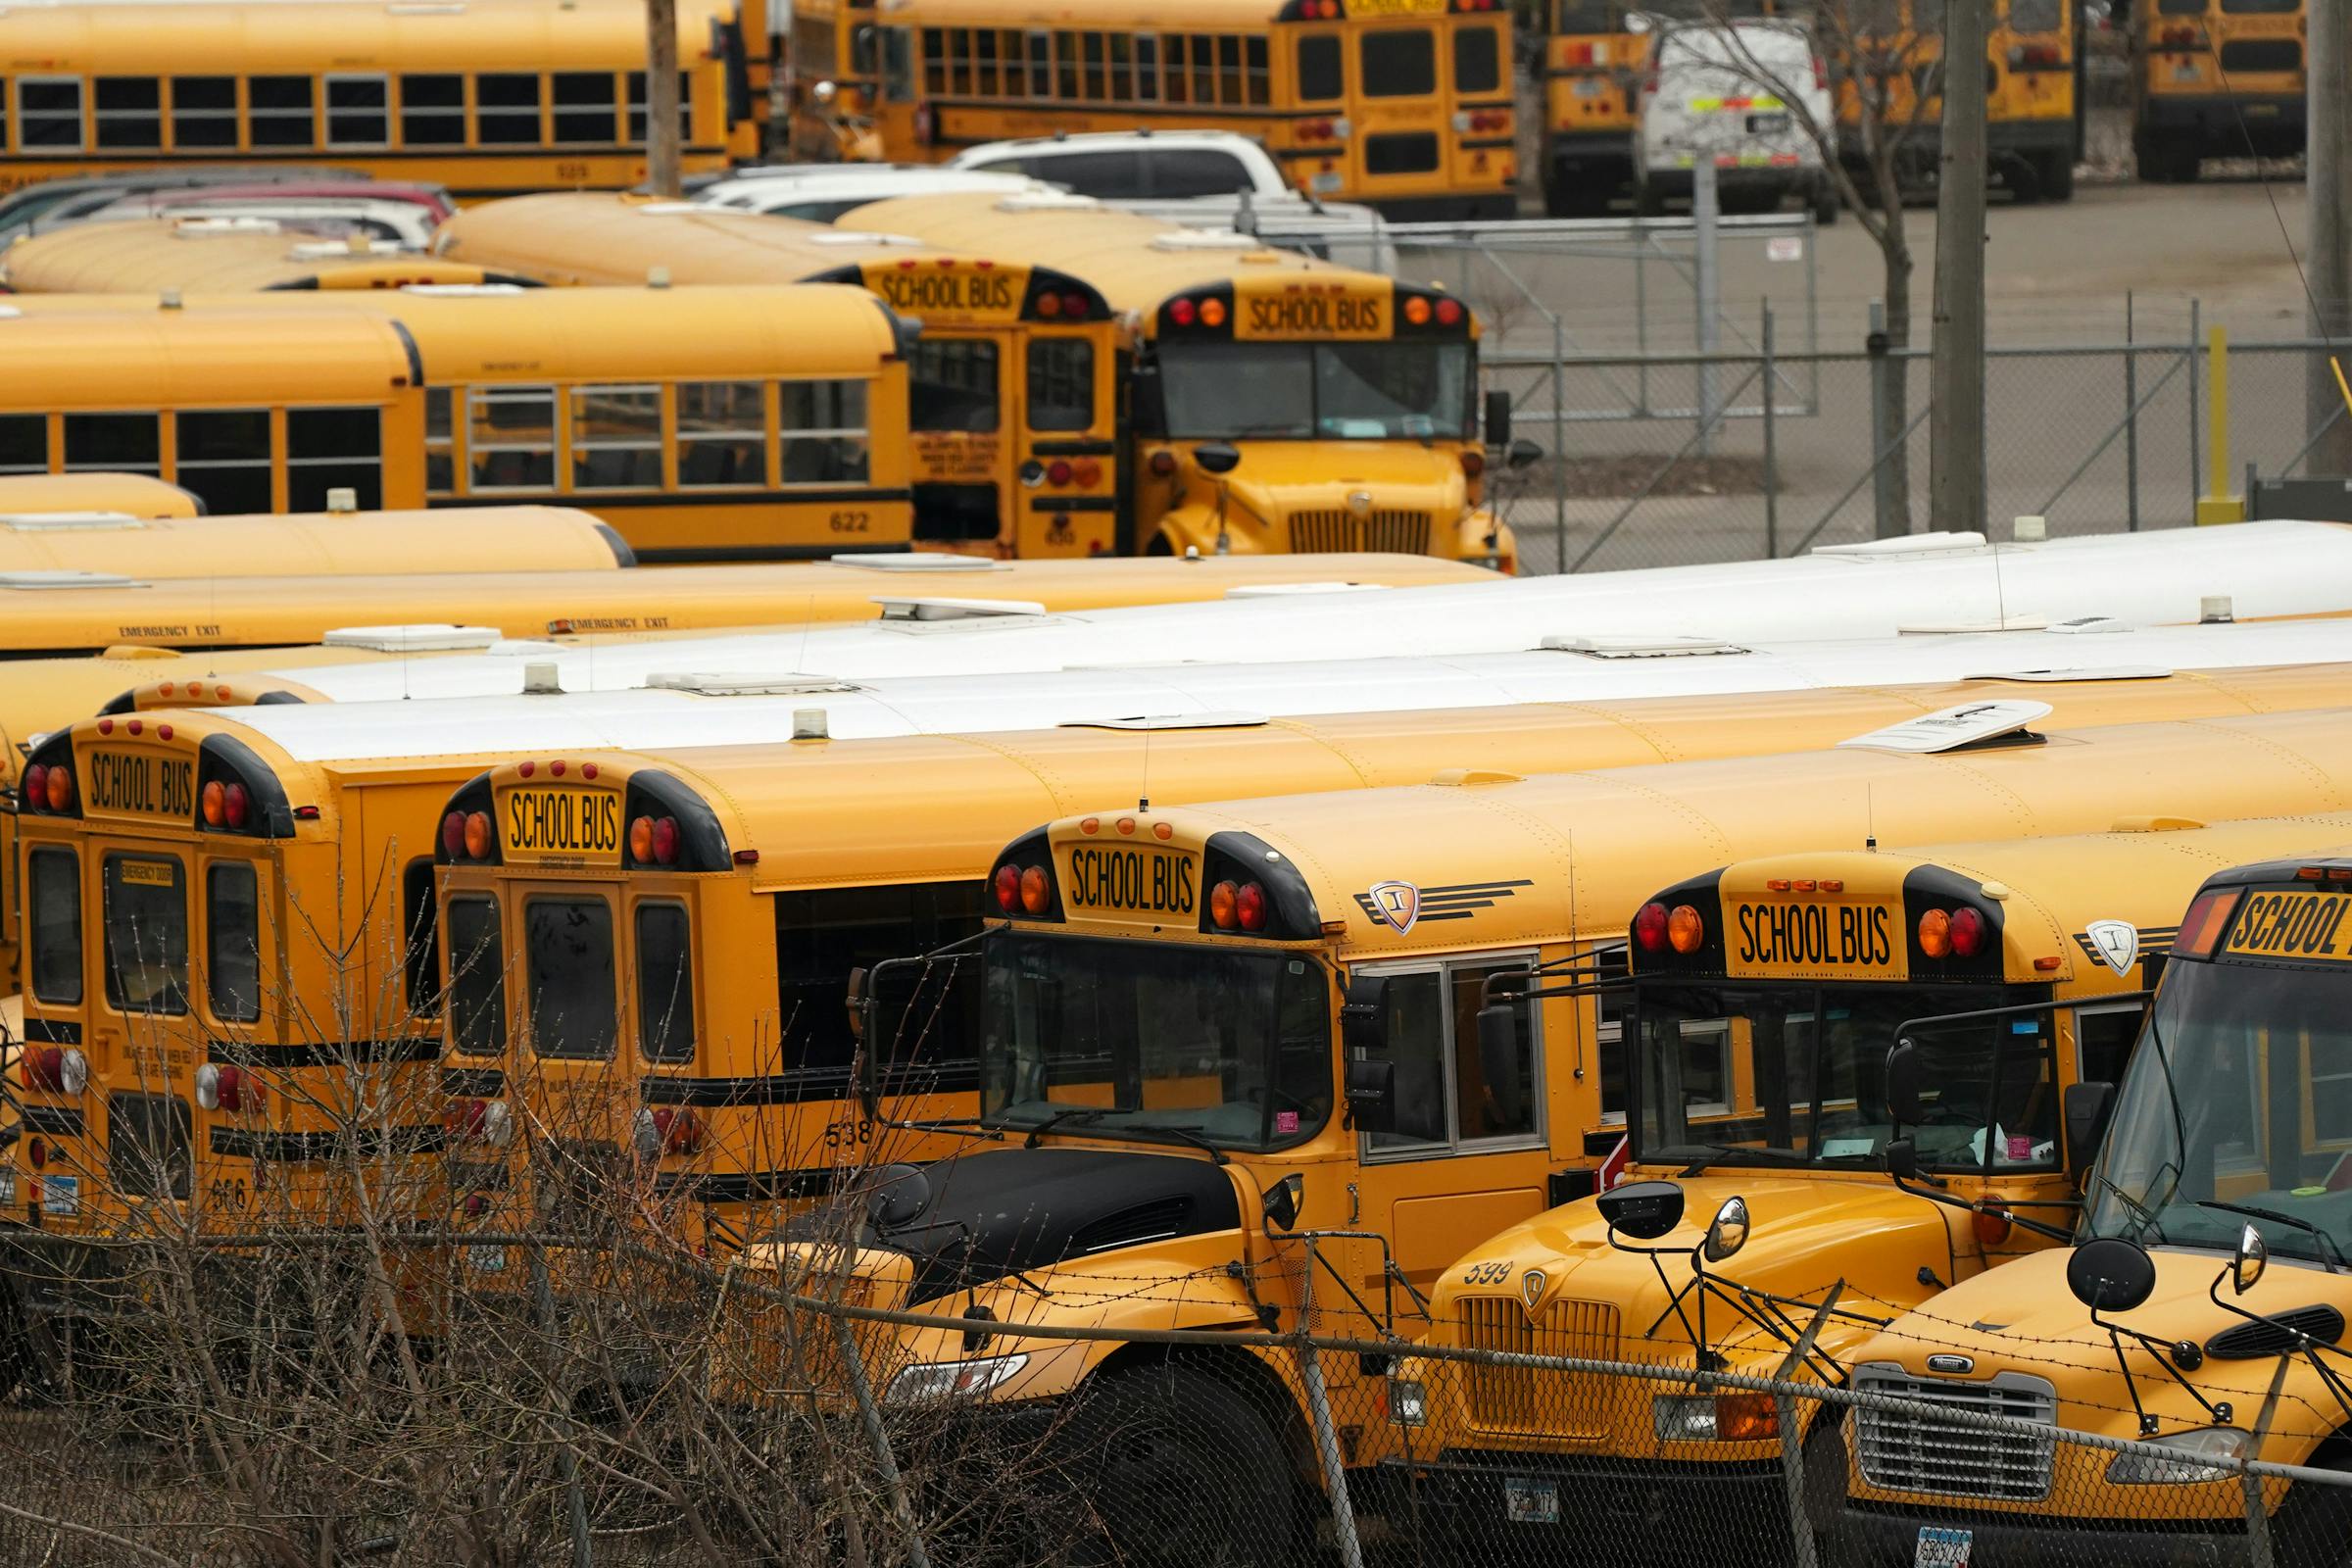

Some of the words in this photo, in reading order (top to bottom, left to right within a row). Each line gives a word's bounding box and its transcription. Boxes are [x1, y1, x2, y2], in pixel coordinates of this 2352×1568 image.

[883, 275, 964, 309] SCHOOL
[969, 275, 1010, 309] BUS
[1250, 298, 1333, 331] SCHOOL
[1337, 299, 1379, 331] BUS
[830, 511, 868, 532] 622
[119, 626, 187, 638] EMERGENCY
[196, 625, 220, 636] EXIT
[571, 618, 636, 629] EMERGENCY
[644, 617, 668, 628] EXIT
[91, 753, 154, 811] SCHOOL
[161, 760, 191, 815] BUS
[511, 793, 579, 849] SCHOOL
[582, 794, 616, 851] BUS
[1072, 849, 1150, 909] SCHOOL
[1153, 854, 1193, 913] BUS
[1739, 904, 1838, 964] SCHOOL
[1841, 906, 1890, 965] BUS
[2232, 895, 2351, 954] SCHOOL
[1464, 1261, 1513, 1284] 599
